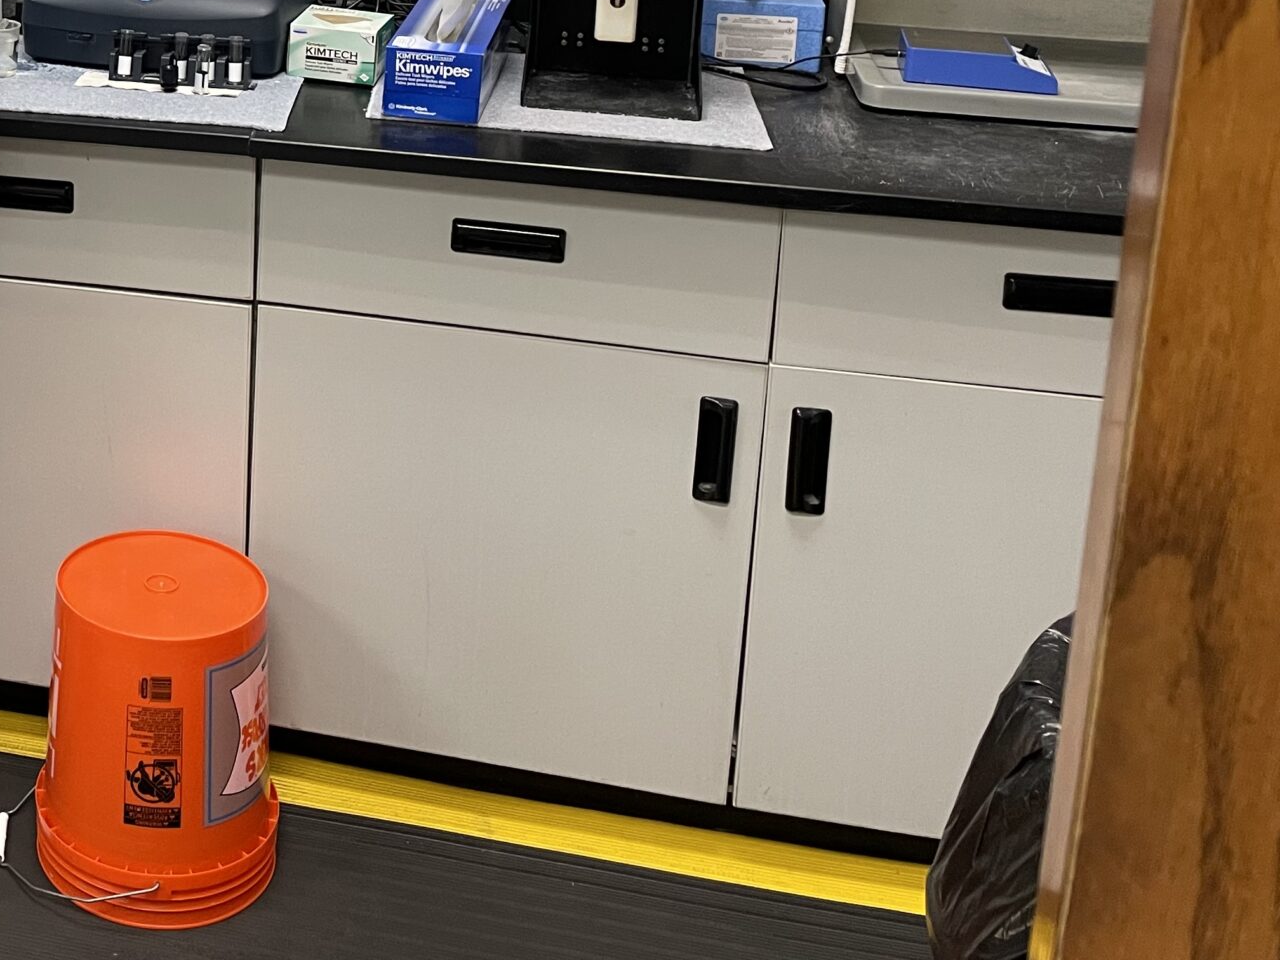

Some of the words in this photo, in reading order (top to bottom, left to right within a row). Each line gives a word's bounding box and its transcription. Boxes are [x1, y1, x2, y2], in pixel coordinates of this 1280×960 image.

[305, 46, 359, 61] KIMTECH
[396, 51, 433, 62] KIMTECH
[395, 58, 471, 80] Kimwipes
